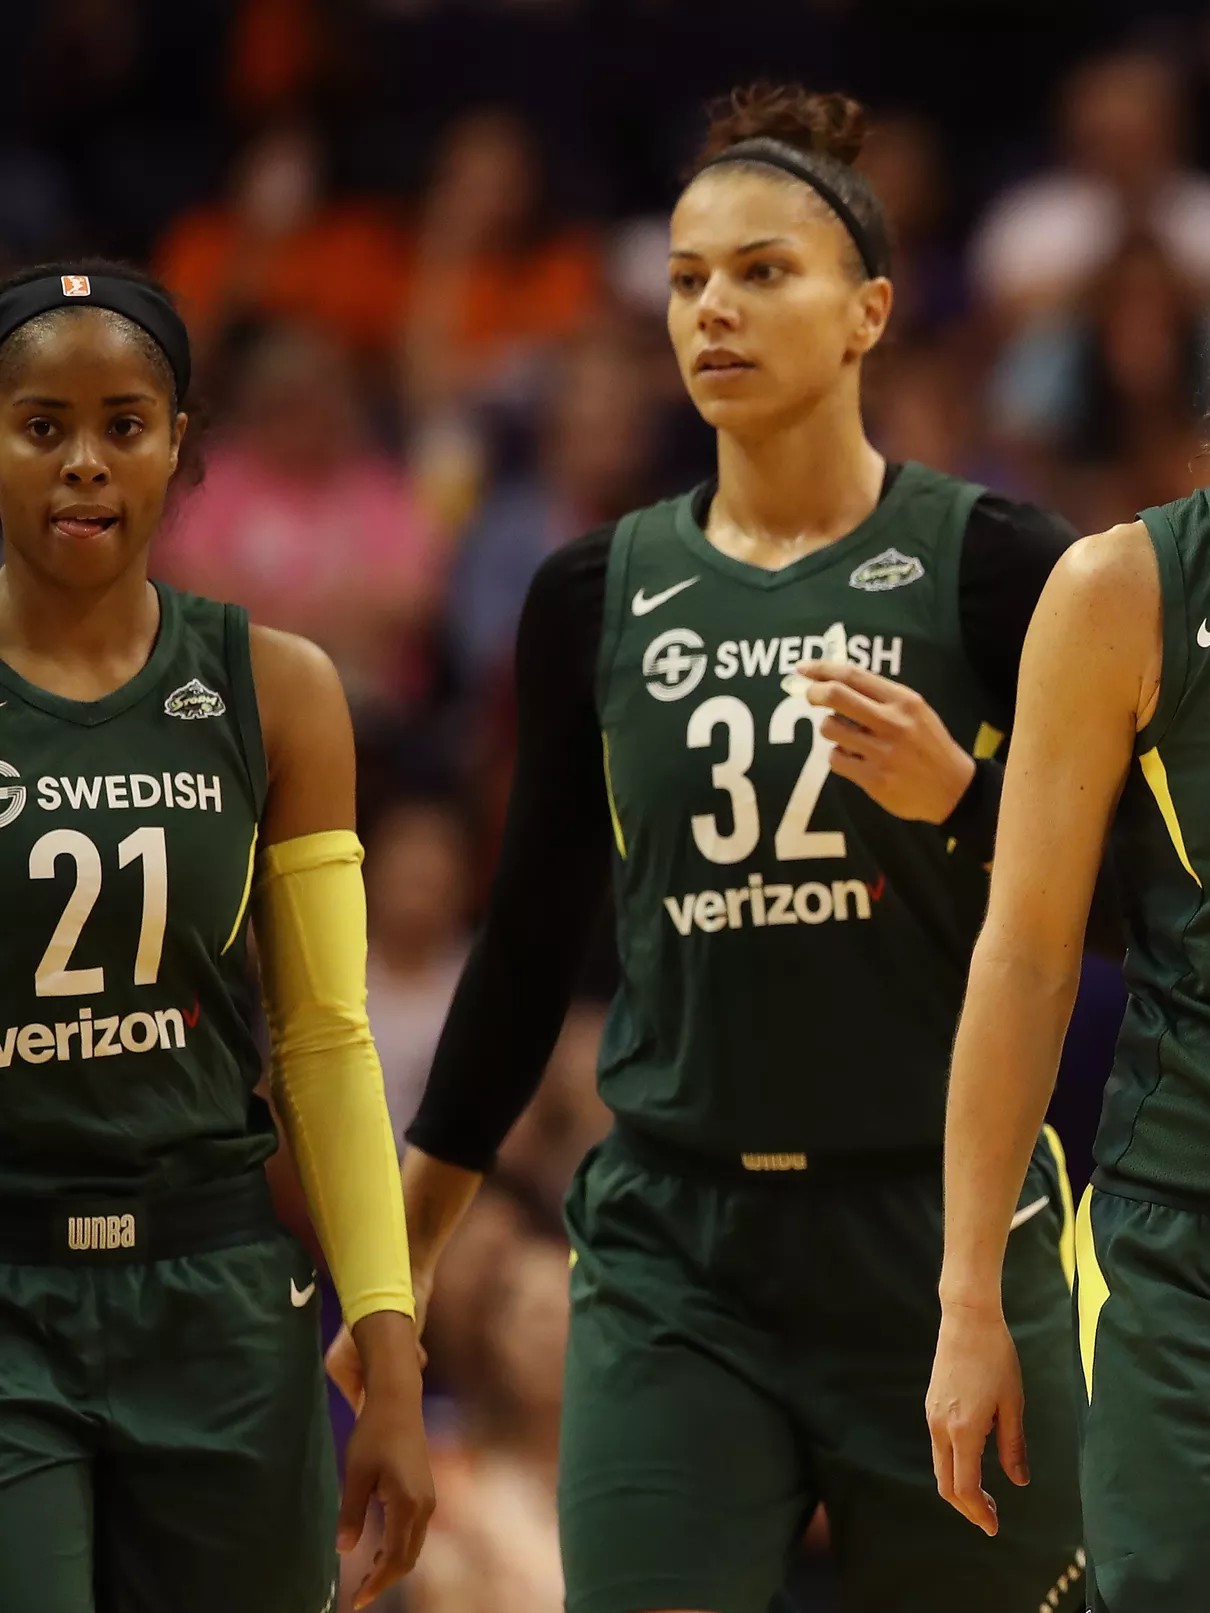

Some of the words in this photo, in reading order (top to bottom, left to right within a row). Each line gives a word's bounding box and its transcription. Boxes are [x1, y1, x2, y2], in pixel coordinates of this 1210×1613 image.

[714, 634, 903, 680] SWEDSH
[37, 771, 222, 813] SWEDISH
[686, 694, 847, 865] 32
[28, 826, 168, 997] 21
[664, 873, 871, 936] verizon
